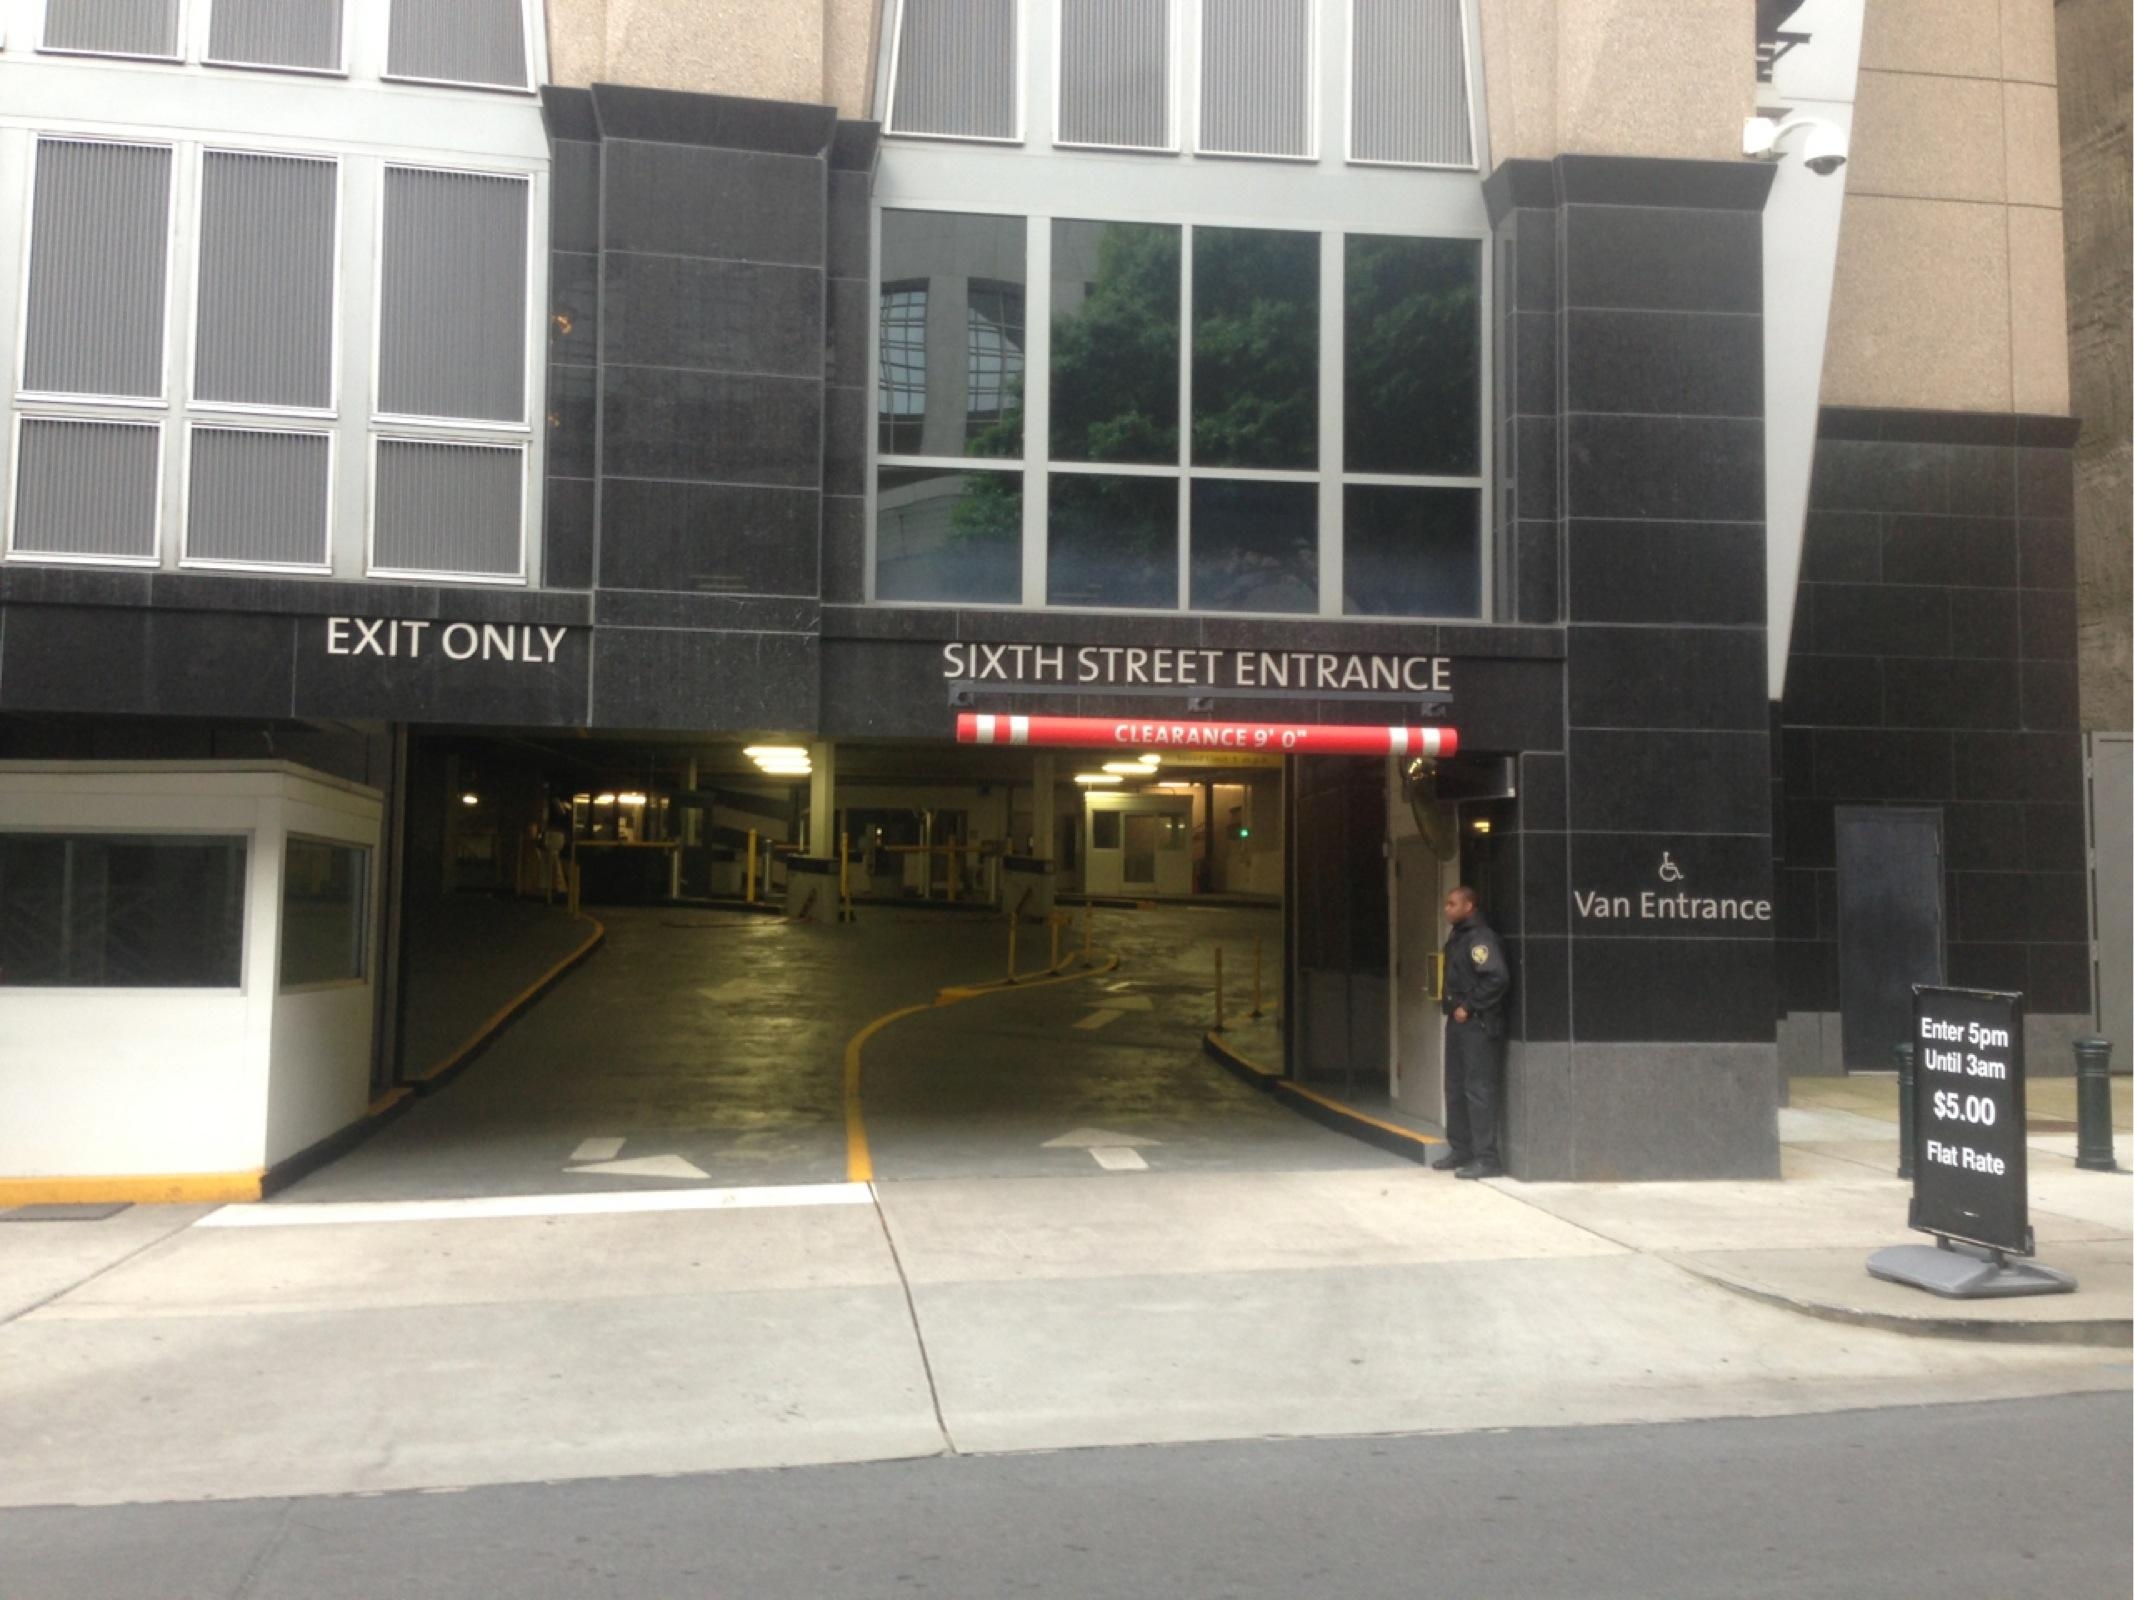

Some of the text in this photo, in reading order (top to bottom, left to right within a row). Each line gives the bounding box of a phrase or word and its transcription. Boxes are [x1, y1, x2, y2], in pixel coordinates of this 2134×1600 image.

[326, 617, 568, 663] EXIT ONLY
[943, 642, 1452, 691] SIXTH STREET ENTRANCE
[1113, 724, 1248, 747] CLEARANCE
[1573, 890, 1772, 921] Van Entrance
[1921, 1016, 2009, 1051] Enter 5pm
[1924, 1048, 2006, 1080] Until 3am
[1932, 1088, 1996, 1127] $5.00
[1926, 1140, 2005, 1176] Flat Rate
